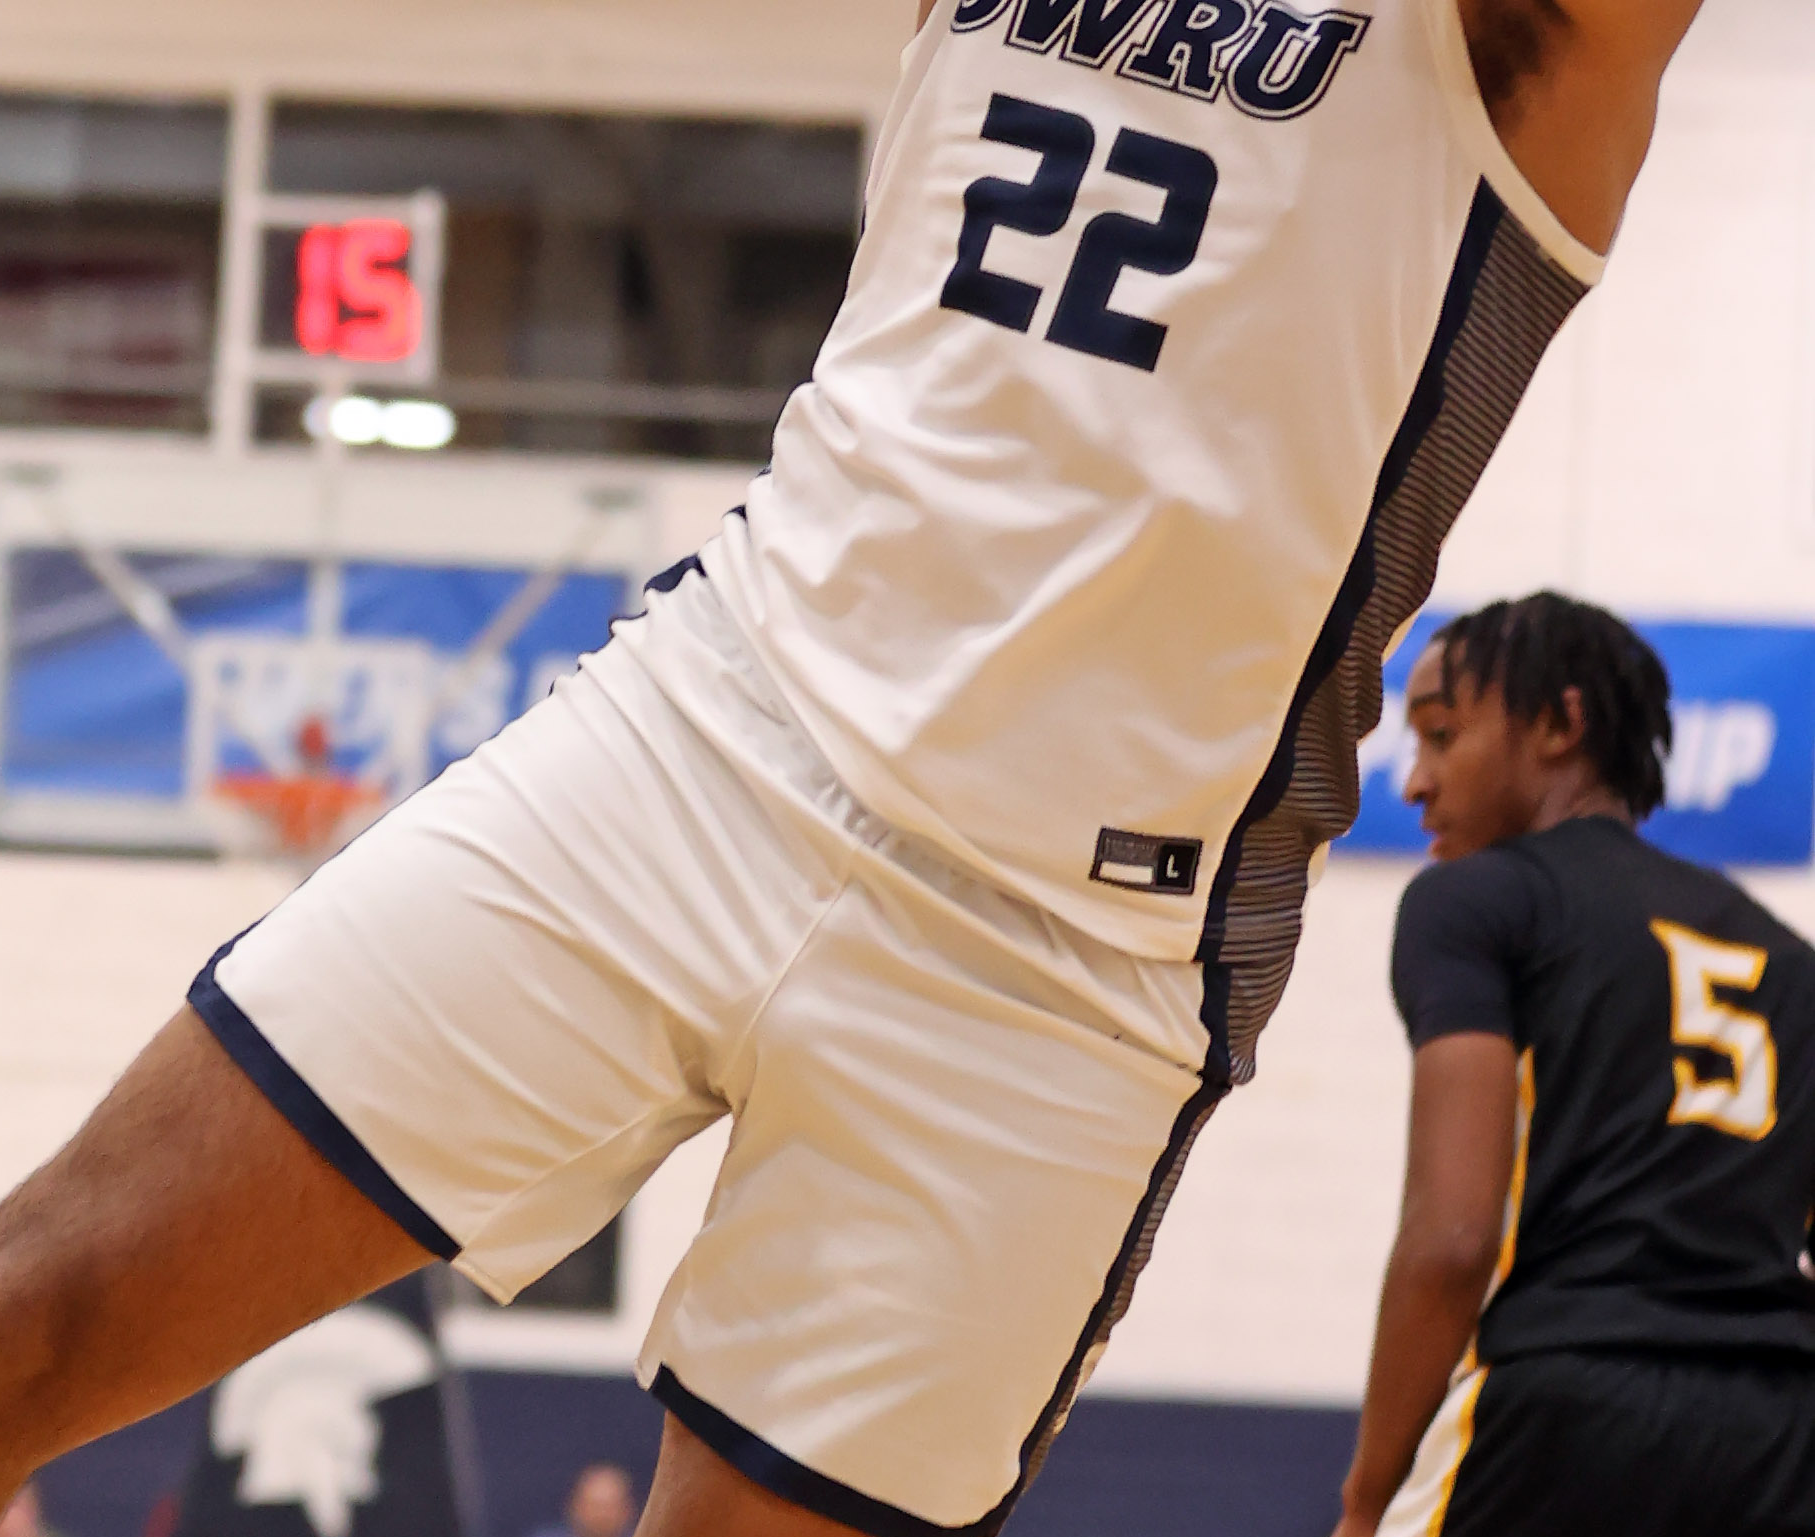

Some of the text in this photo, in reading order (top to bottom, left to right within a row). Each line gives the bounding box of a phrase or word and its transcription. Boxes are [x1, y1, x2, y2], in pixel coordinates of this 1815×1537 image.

[296, 218, 423, 364] 15
[939, 92, 1219, 373] 22
[1649, 918, 1779, 1143] 5
